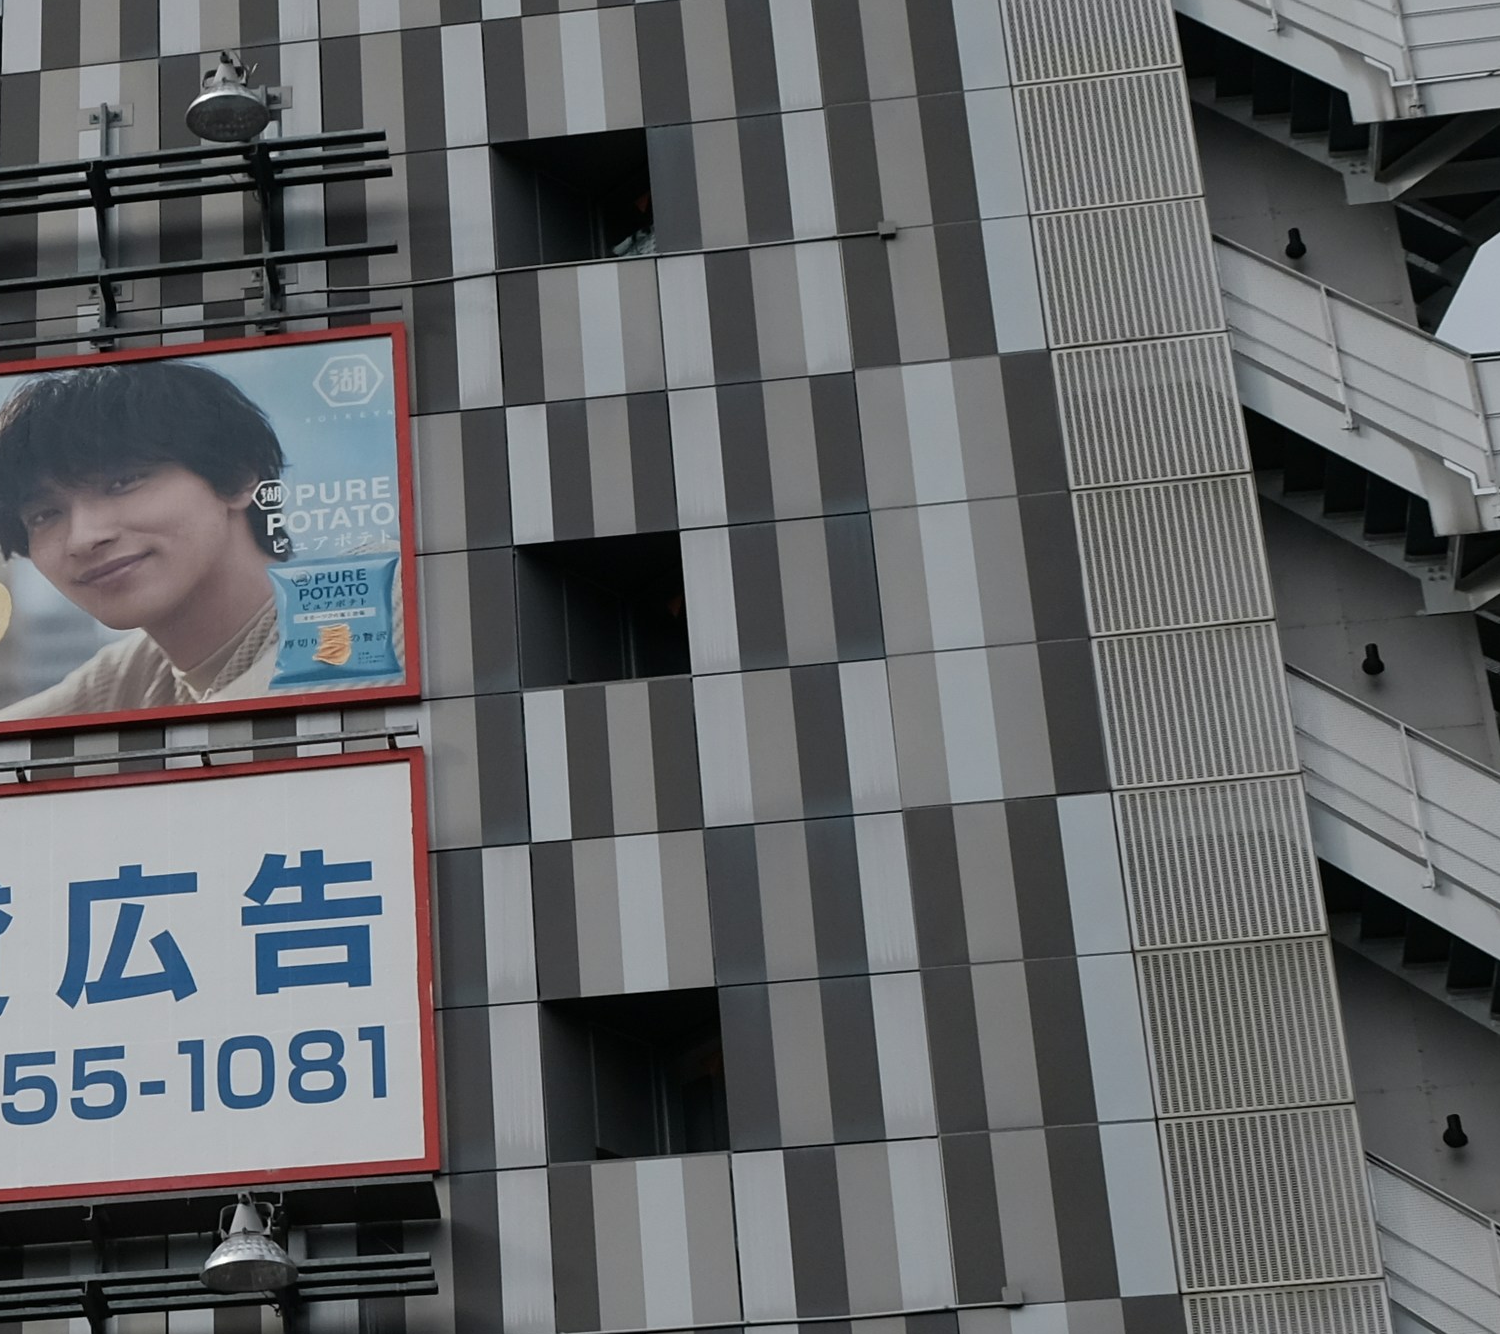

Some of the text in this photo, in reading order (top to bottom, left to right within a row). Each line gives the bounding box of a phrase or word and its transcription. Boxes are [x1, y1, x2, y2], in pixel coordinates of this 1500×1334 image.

[328, 366, 368, 397] 湖
[296, 476, 391, 507] PURE
[266, 502, 396, 537] POTATO
[272, 528, 392, 555] ピュアポテト
[314, 568, 367, 585] PURE
[299, 582, 369, 602] POTATO
